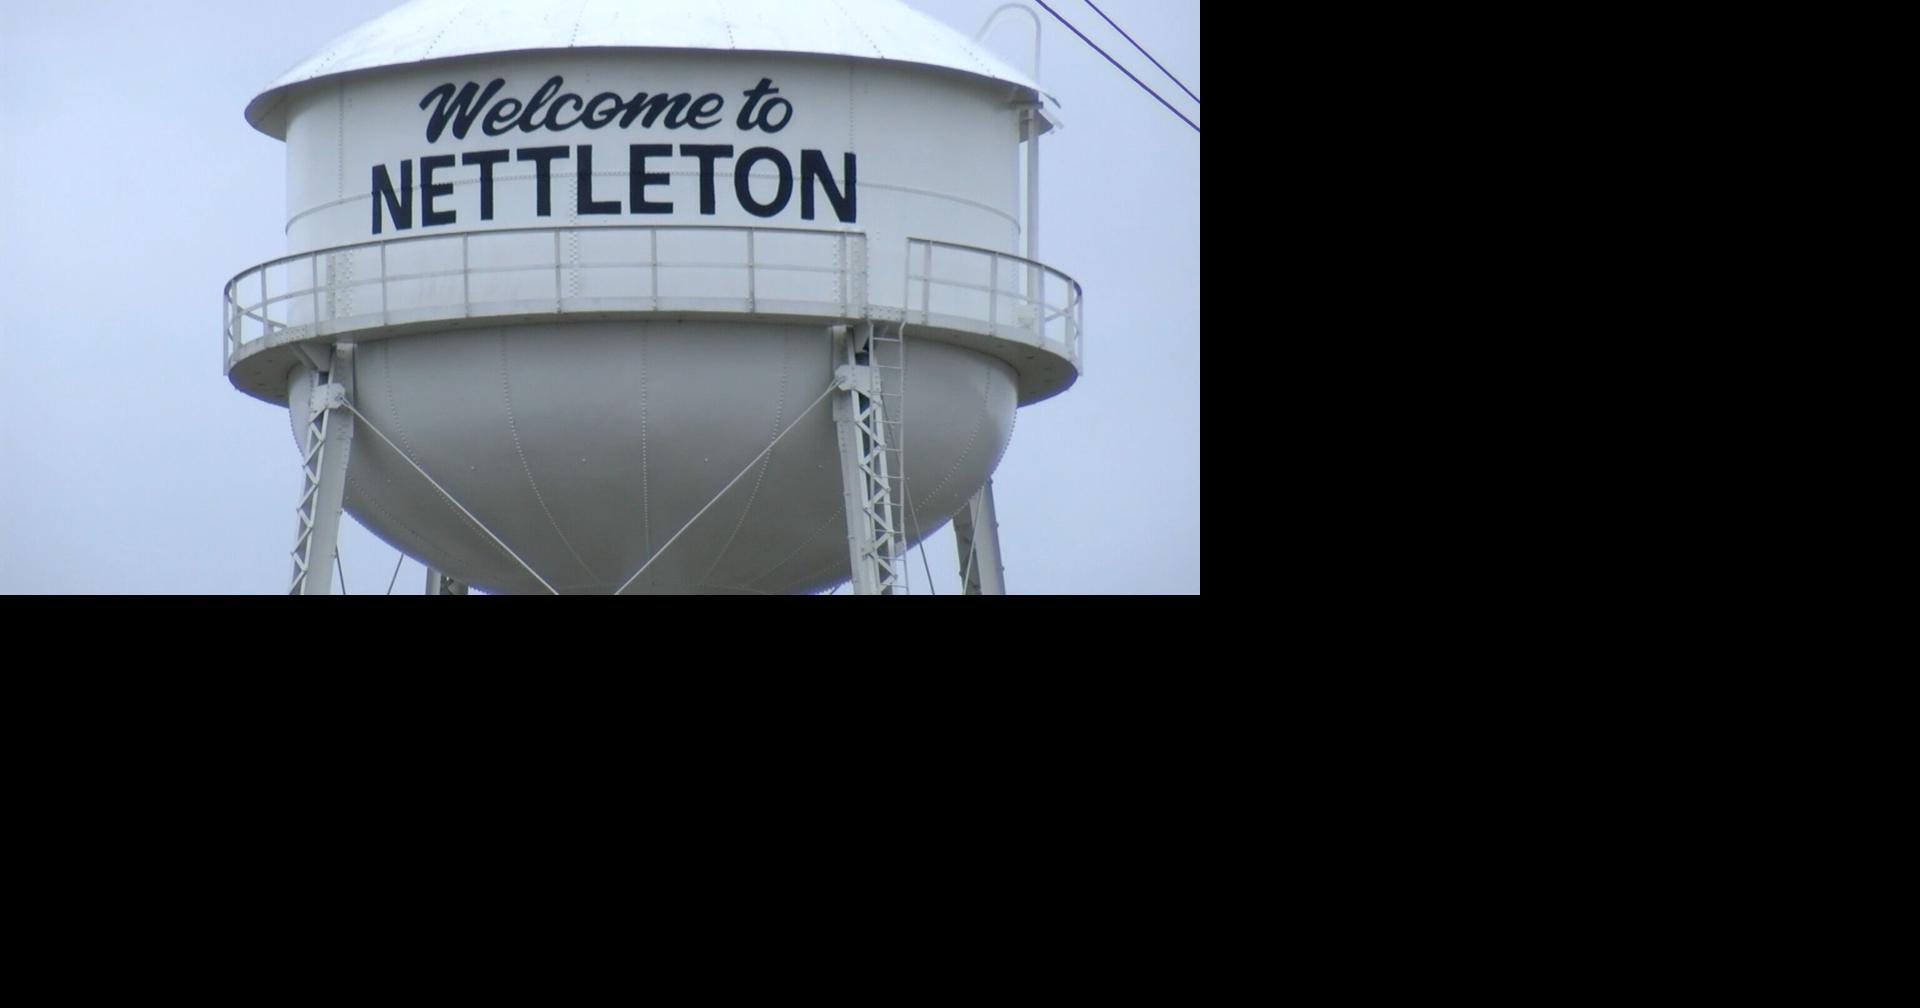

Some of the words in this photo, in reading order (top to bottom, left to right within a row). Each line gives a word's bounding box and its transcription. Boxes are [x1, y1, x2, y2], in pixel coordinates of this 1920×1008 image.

[419, 75, 724, 144] Welcome
[736, 77, 794, 134] to
[371, 143, 857, 235] NETTLETON
